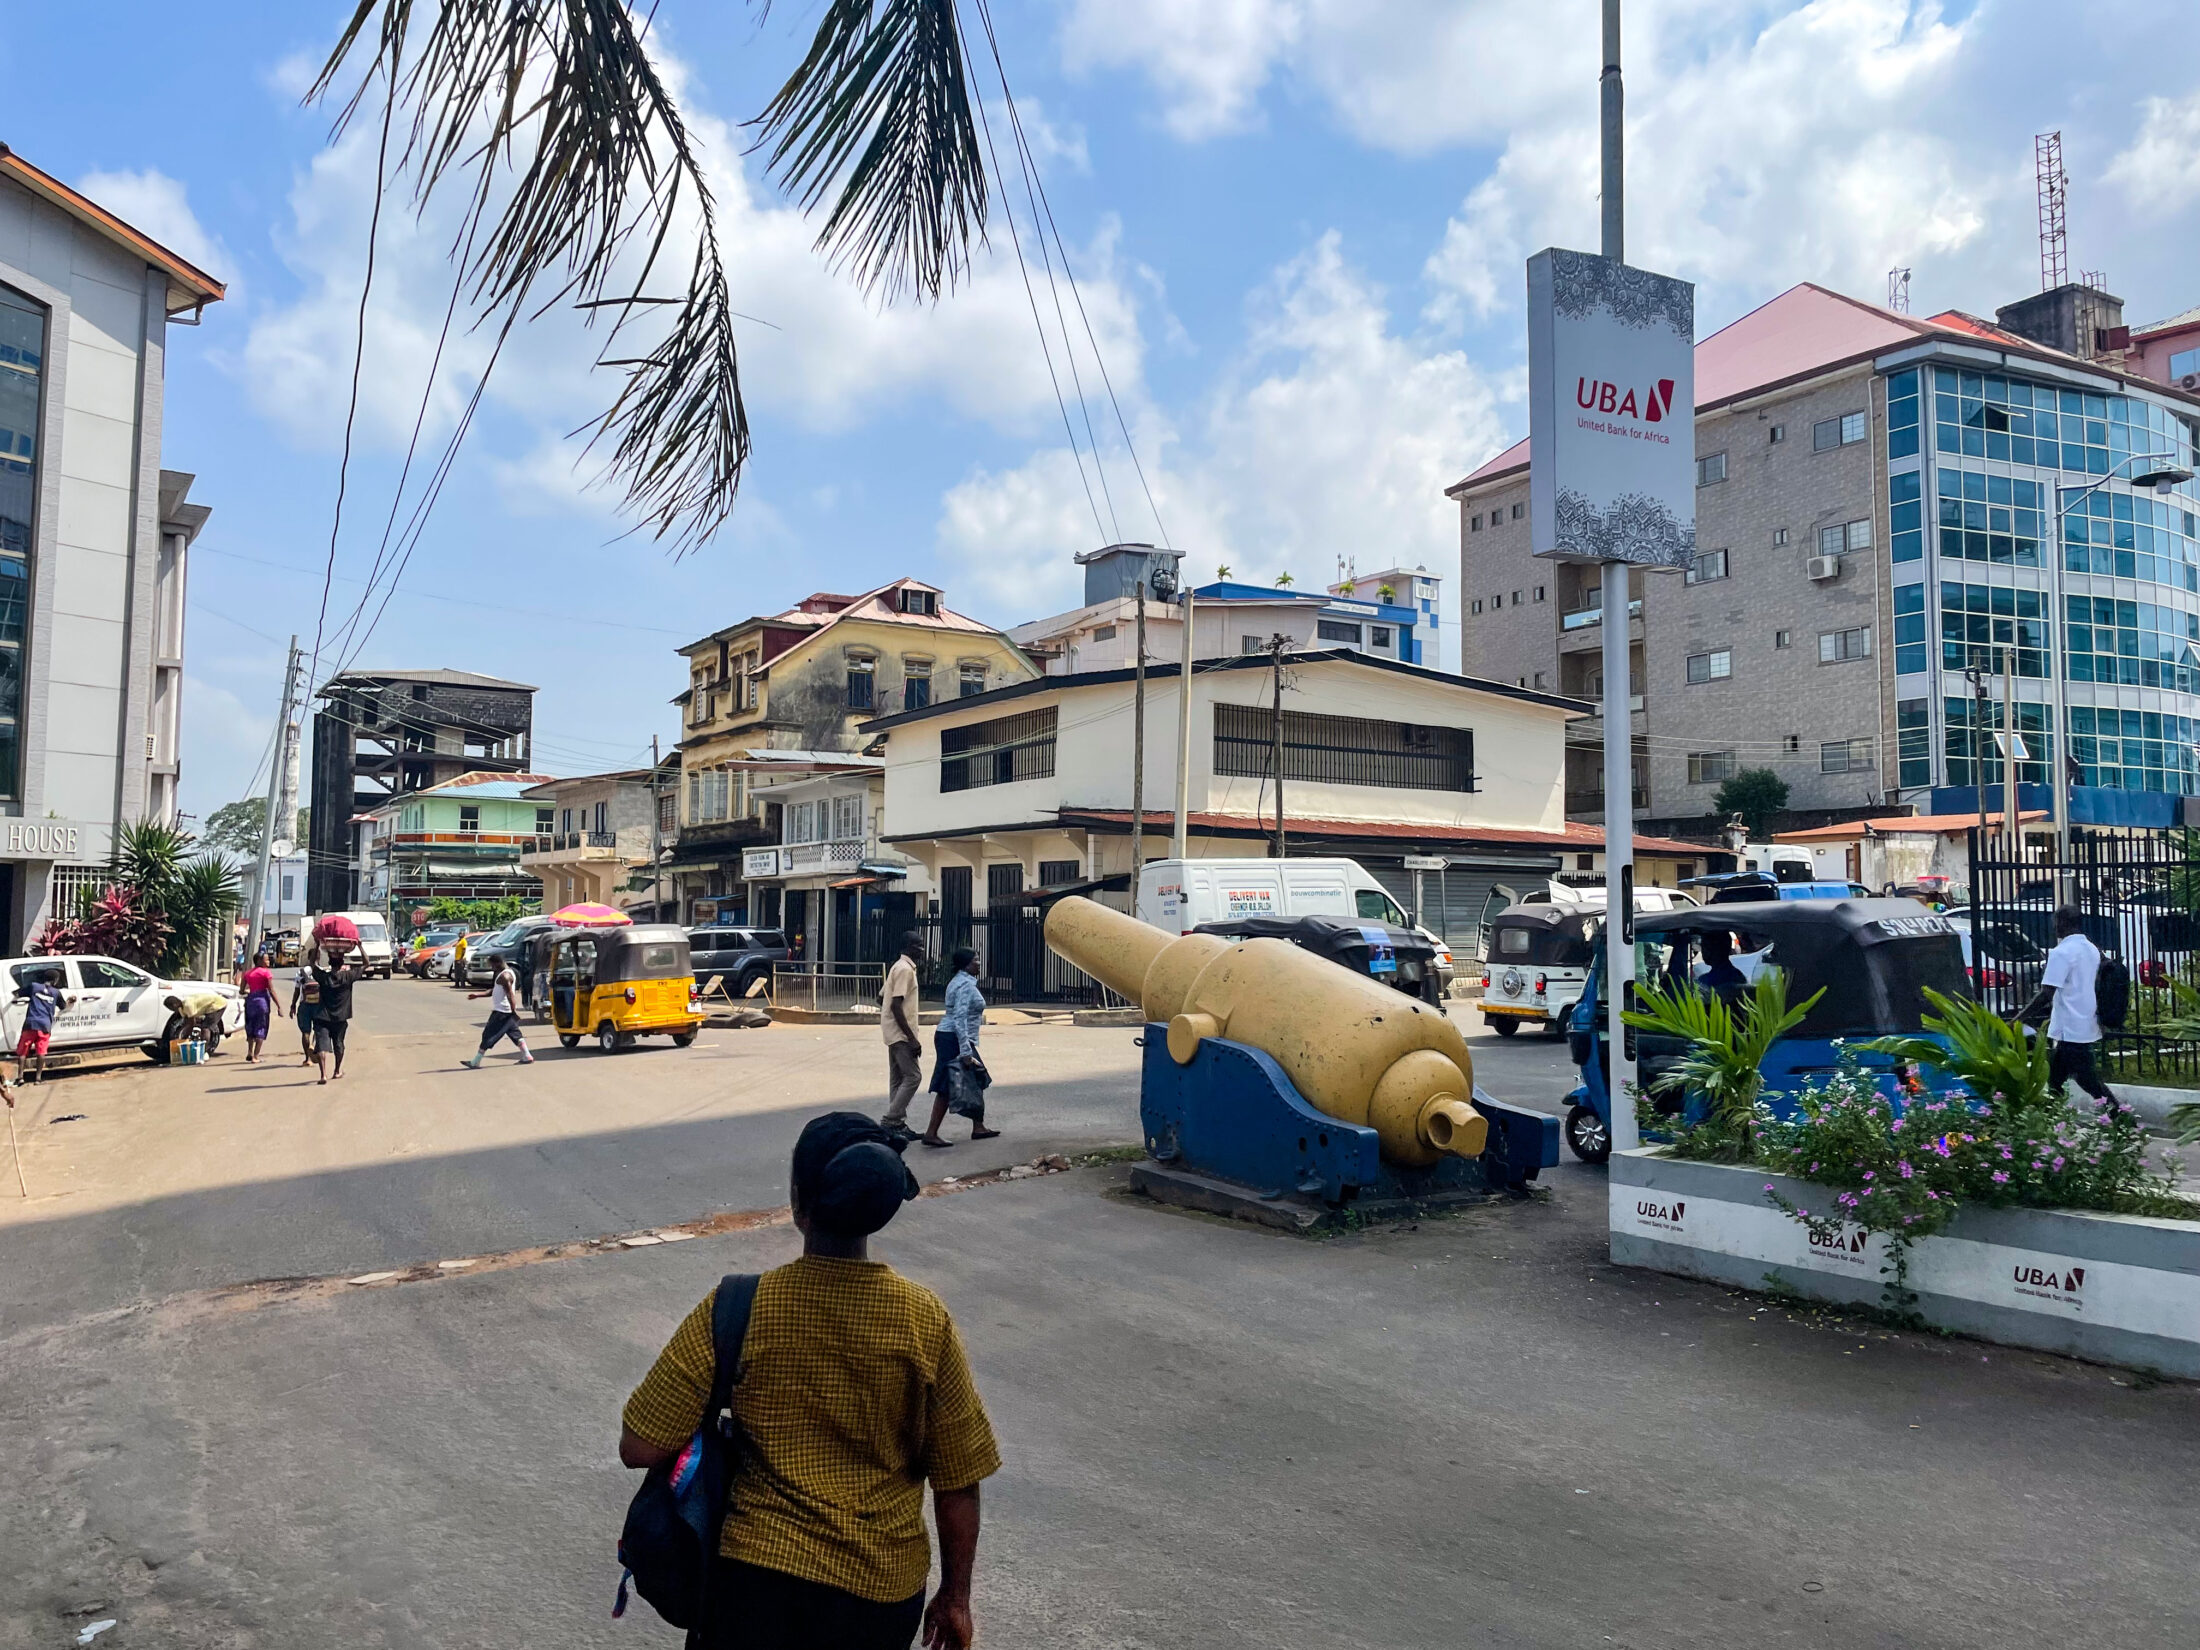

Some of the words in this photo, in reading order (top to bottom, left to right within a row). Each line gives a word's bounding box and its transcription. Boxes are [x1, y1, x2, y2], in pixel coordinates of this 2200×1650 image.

[1577, 376, 1638, 419] UBA
[1577, 417, 1605, 433] United
[1607, 423, 1628, 437] Bank
[1630, 427, 1642, 439] for
[1644, 431, 1670, 445] Africa
[7, 824, 78, 854] HOUSE
[1228, 891, 1257, 901] DELIVERY
[1259, 891, 1271, 901] VAN
[1290, 889, 1342, 897] bouwcombinatie
[1637, 1201, 1668, 1220] UBA
[1808, 1230, 1846, 1251] UBA
[1809, 1247, 1826, 1257] United
[1827, 1251, 1839, 1259] Bank
[1850, 1256, 1865, 1265] Africa
[2014, 1265, 2059, 1290] UBA
[2014, 1286, 2035, 1296] United
[2036, 1289, 2051, 1299] Bank
